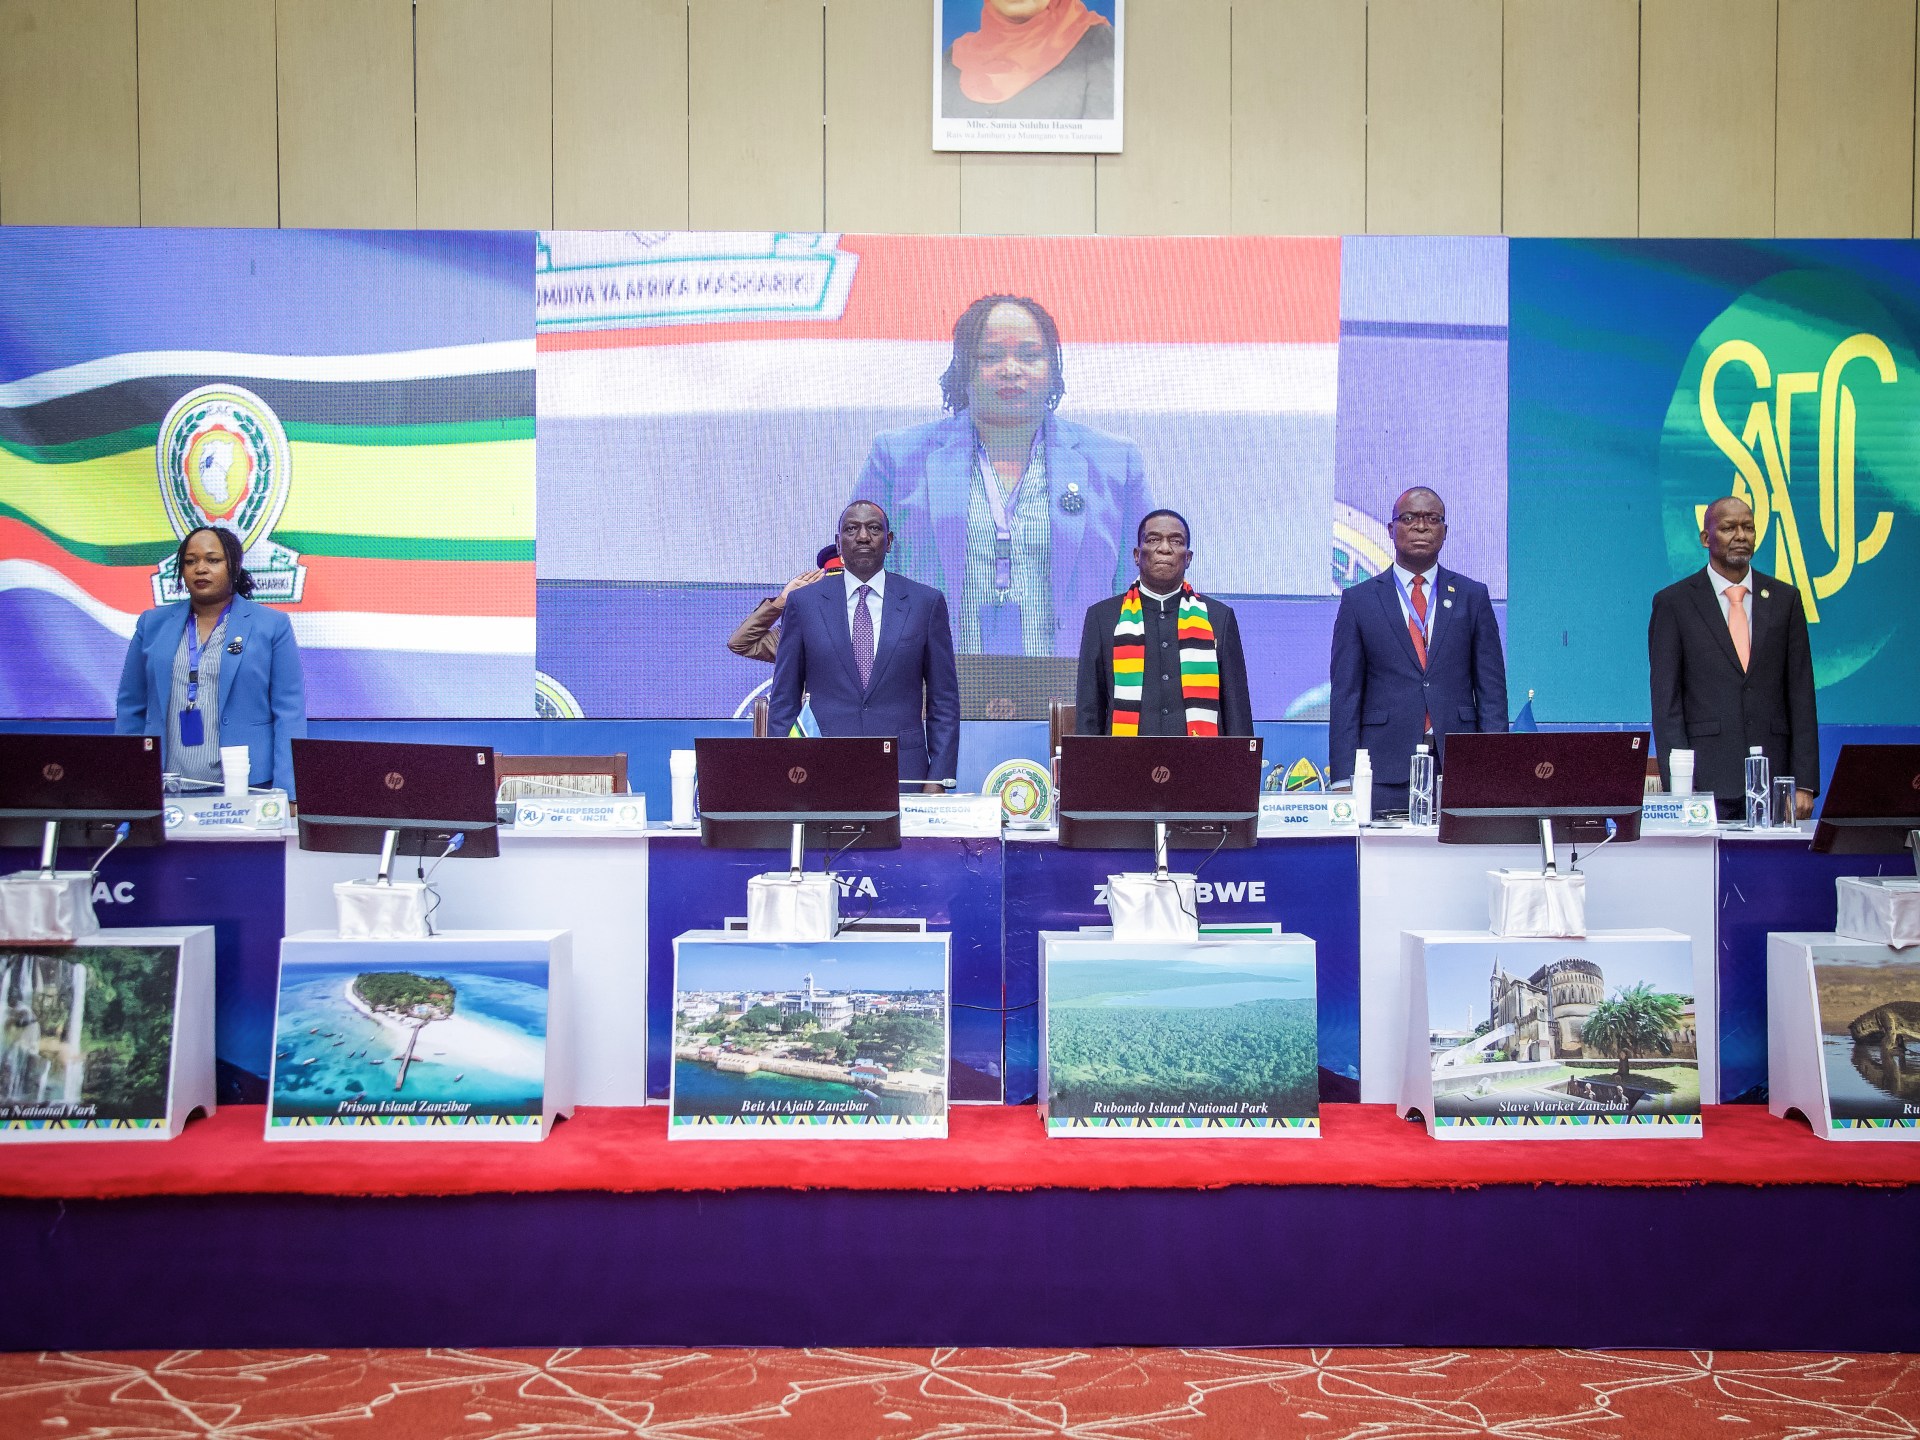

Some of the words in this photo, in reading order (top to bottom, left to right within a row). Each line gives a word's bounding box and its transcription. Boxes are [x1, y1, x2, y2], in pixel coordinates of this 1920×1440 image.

[990, 121, 1017, 129] Samia
[1051, 121, 1083, 130] Hassan
[789, 766, 807, 783] hp
[1153, 766, 1170, 783] hp
[1536, 761, 1554, 779] hp
[387, 772, 404, 790] hp
[213, 802, 232, 810] EAC
[1262, 803, 1328, 812] CHAIRPERSON
[194, 809, 251, 819] SECRETARY
[565, 814, 608, 822] CUNCIL
[198, 817, 244, 826] GENERAL
[92, 881, 136, 903] AC
[1093, 881, 1266, 905] ZBWE
[11, 1103, 67, 1118] National
[67, 1102, 98, 1117] Park
[337, 1100, 376, 1113] Prison
[378, 1100, 417, 1113] Island
[418, 1100, 472, 1112] Zanzibar
[741, 1100, 766, 1112] Beit
[766, 1100, 781, 1112] Al
[782, 1100, 814, 1115] Ajaib
[816, 1099, 869, 1112] Zanzibar
[1092, 1102, 1146, 1114] Rubondo
[1148, 1102, 1185, 1114] Island
[1187, 1102, 1238, 1114] National
[1240, 1102, 1269, 1114] Park
[1499, 1100, 1530, 1112] Slave
[1532, 1100, 1575, 1112] Market
[1577, 1099, 1630, 1112] Zanzibar
